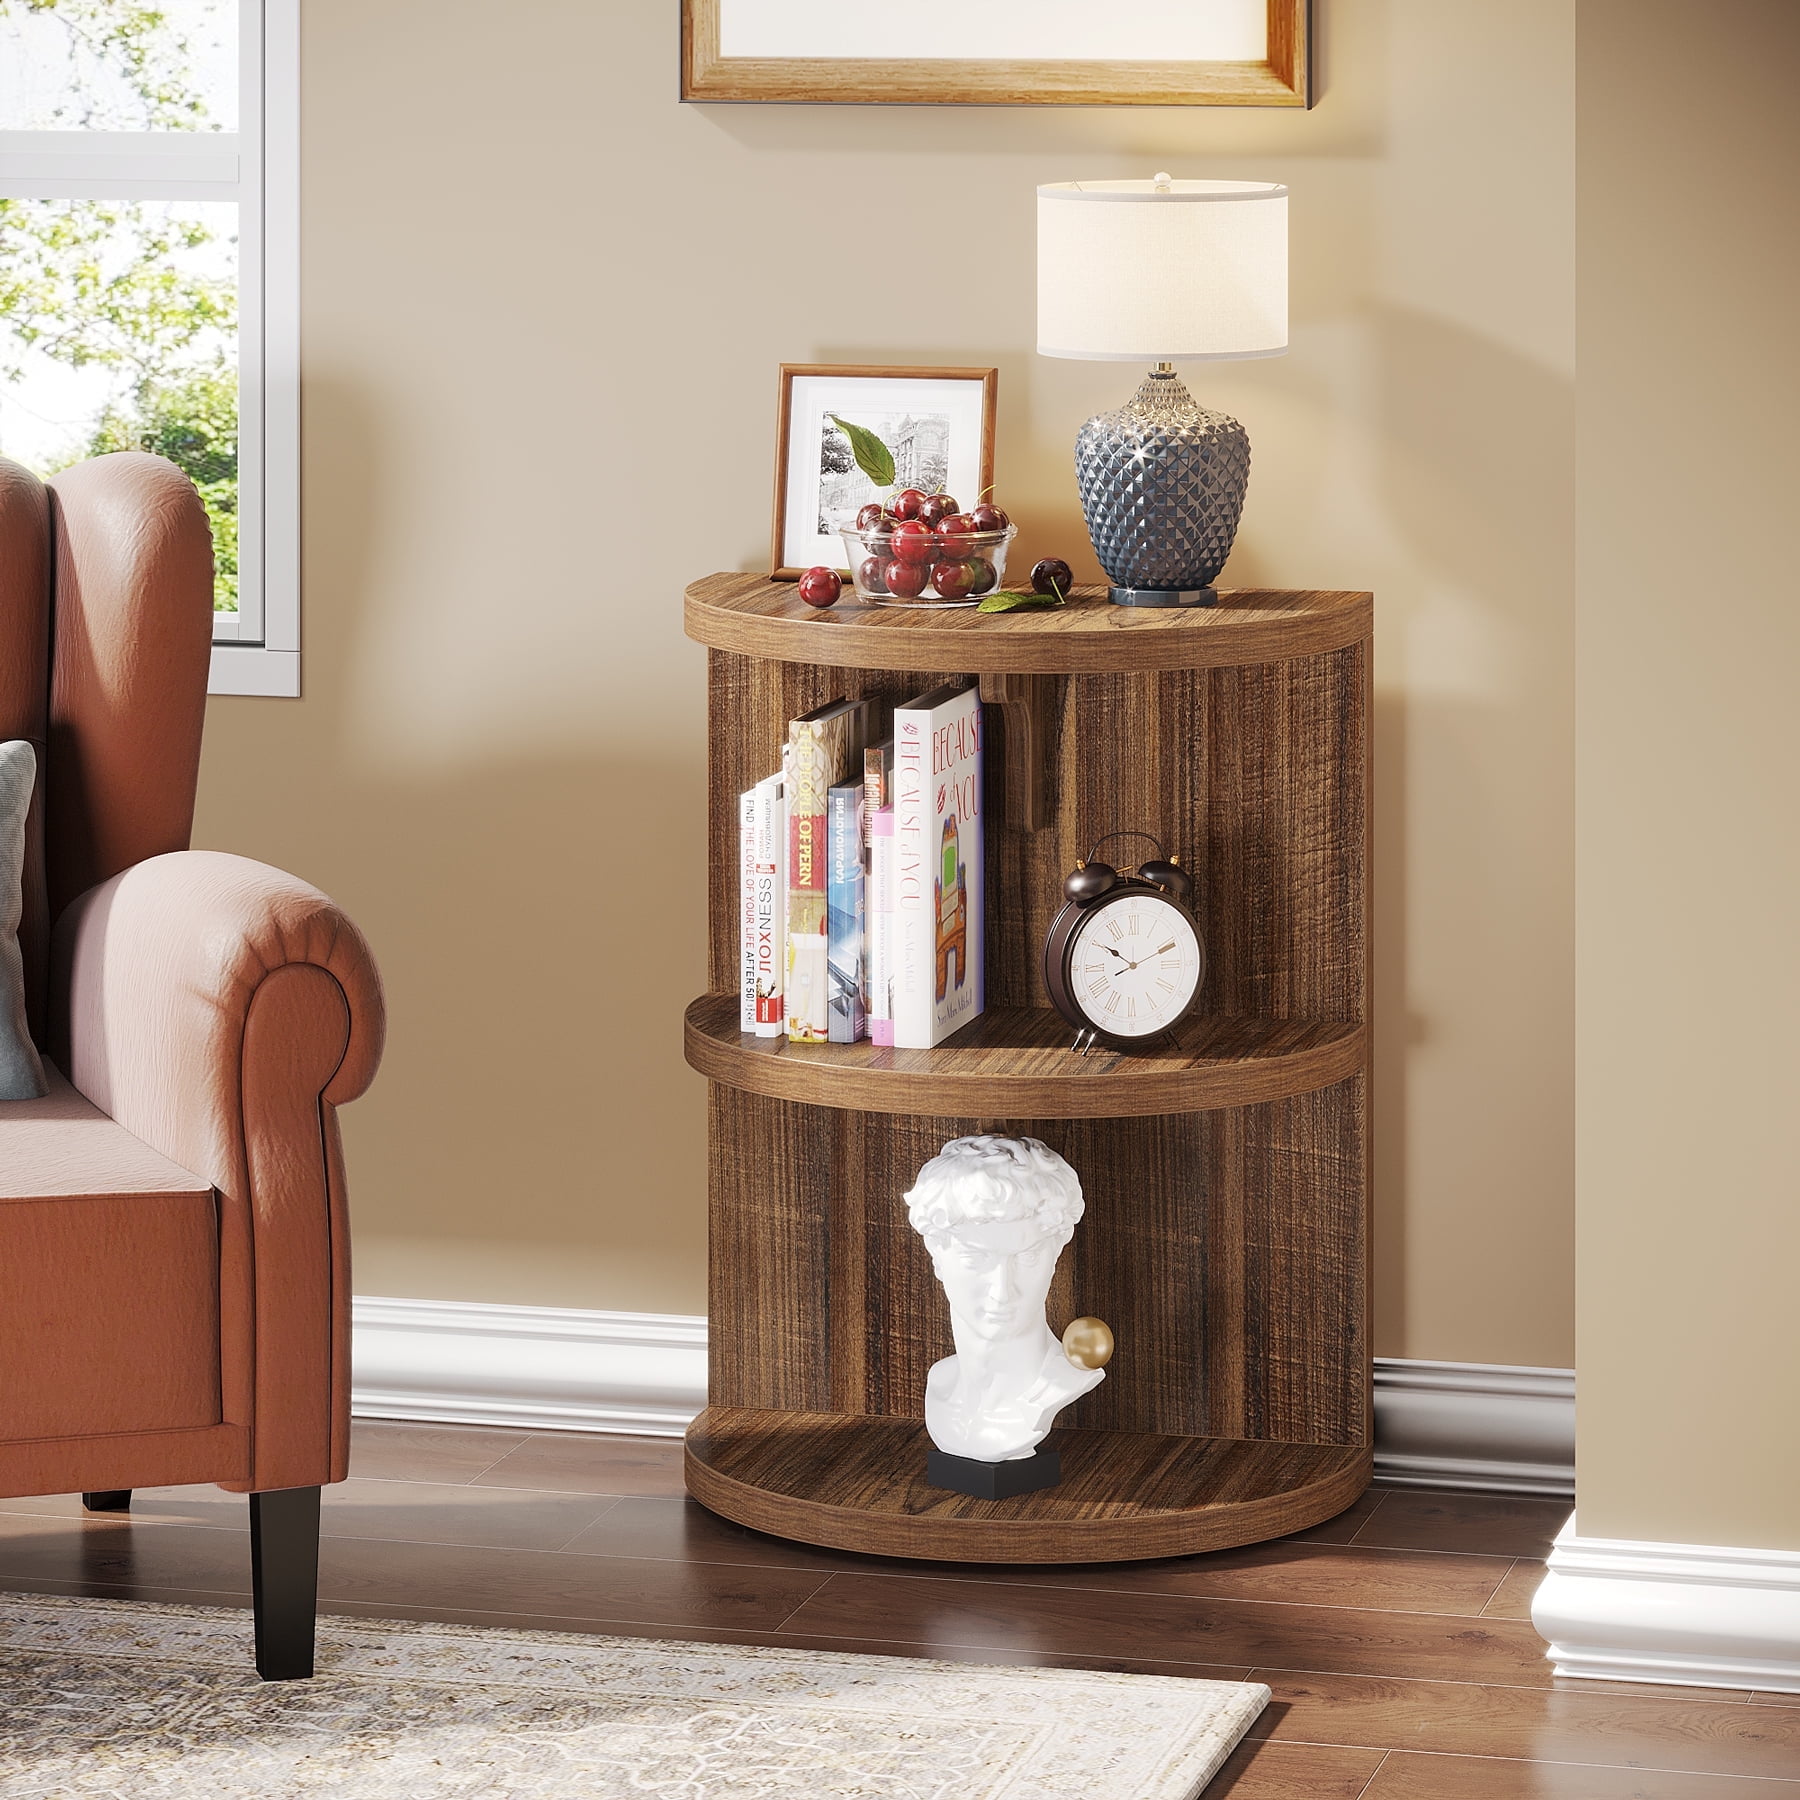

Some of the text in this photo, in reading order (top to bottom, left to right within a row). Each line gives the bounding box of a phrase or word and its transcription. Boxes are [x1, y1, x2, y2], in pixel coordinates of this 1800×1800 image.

[933, 709, 983, 775] BECAUSE
[900, 741, 921, 840] BECAUSE
[955, 773, 979, 825] YOU
[745, 800, 755, 823] FIND
[799, 728, 812, 885] THE PEOPLE OF PERN
[745, 826, 755, 847] THE
[835, 797, 845, 884] КАРДИОЛОГИЯ
[745, 848, 755, 876] LOVE
[745, 879, 755, 892] OF
[900, 862, 921, 911] YOU
[745, 895, 755, 924] YOUR
[1128, 914, 1140, 936] XII
[745, 927, 755, 949] LIFE
[745, 951, 755, 985] AFTER
